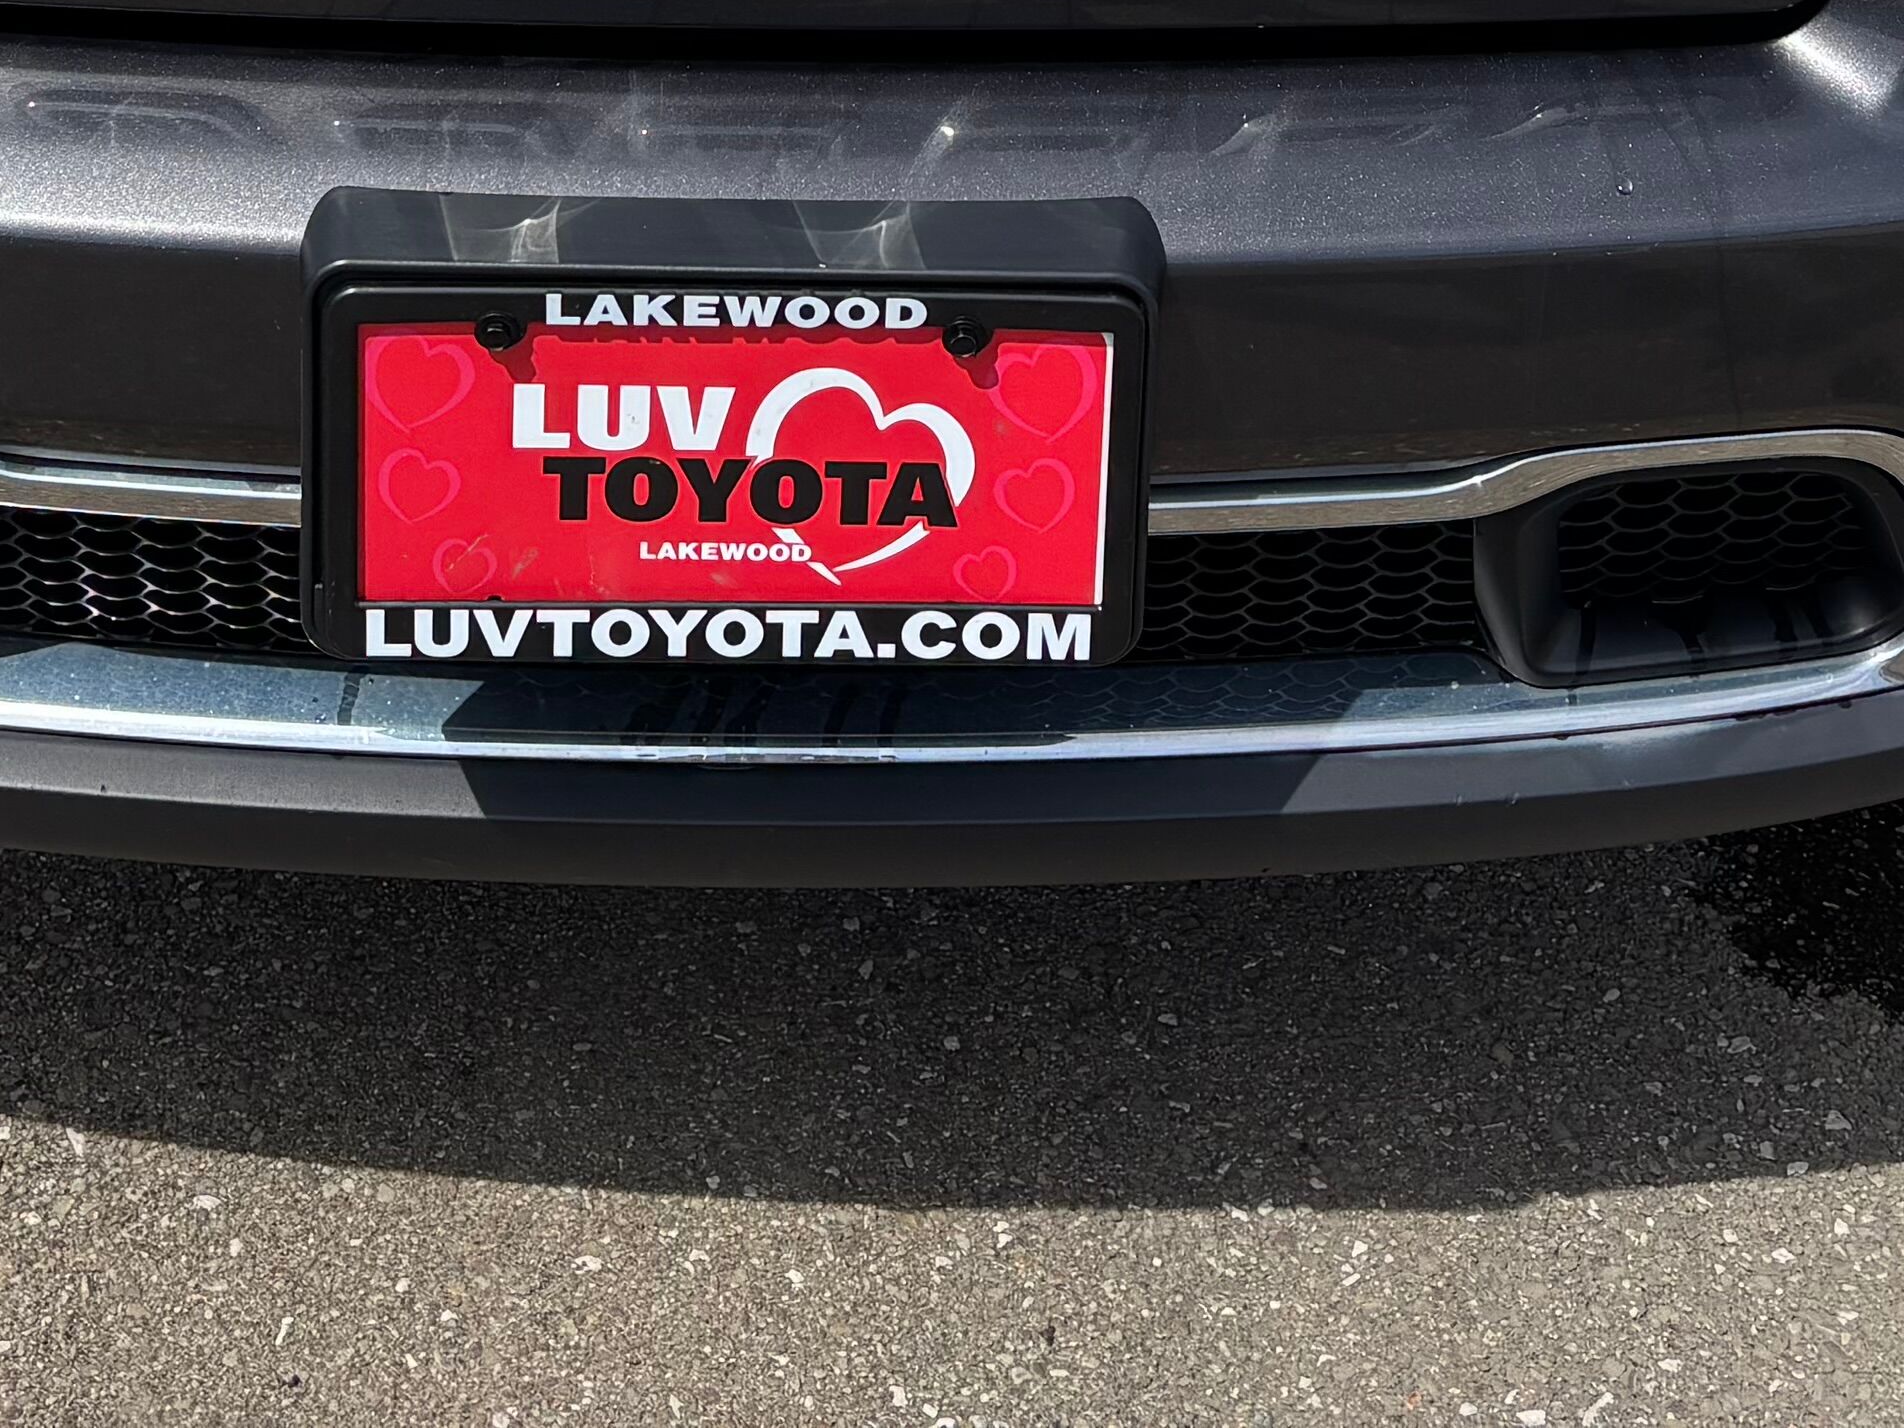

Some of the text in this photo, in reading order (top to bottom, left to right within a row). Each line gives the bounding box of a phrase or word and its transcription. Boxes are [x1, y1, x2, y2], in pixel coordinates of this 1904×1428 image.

[545, 293, 928, 330] LAKEWOOD
[512, 383, 736, 452] LUV
[542, 456, 958, 529] TOYOTA
[639, 540, 813, 564] LAKEWOOD
[365, 607, 1093, 662] LUVTOYOTA.COM
